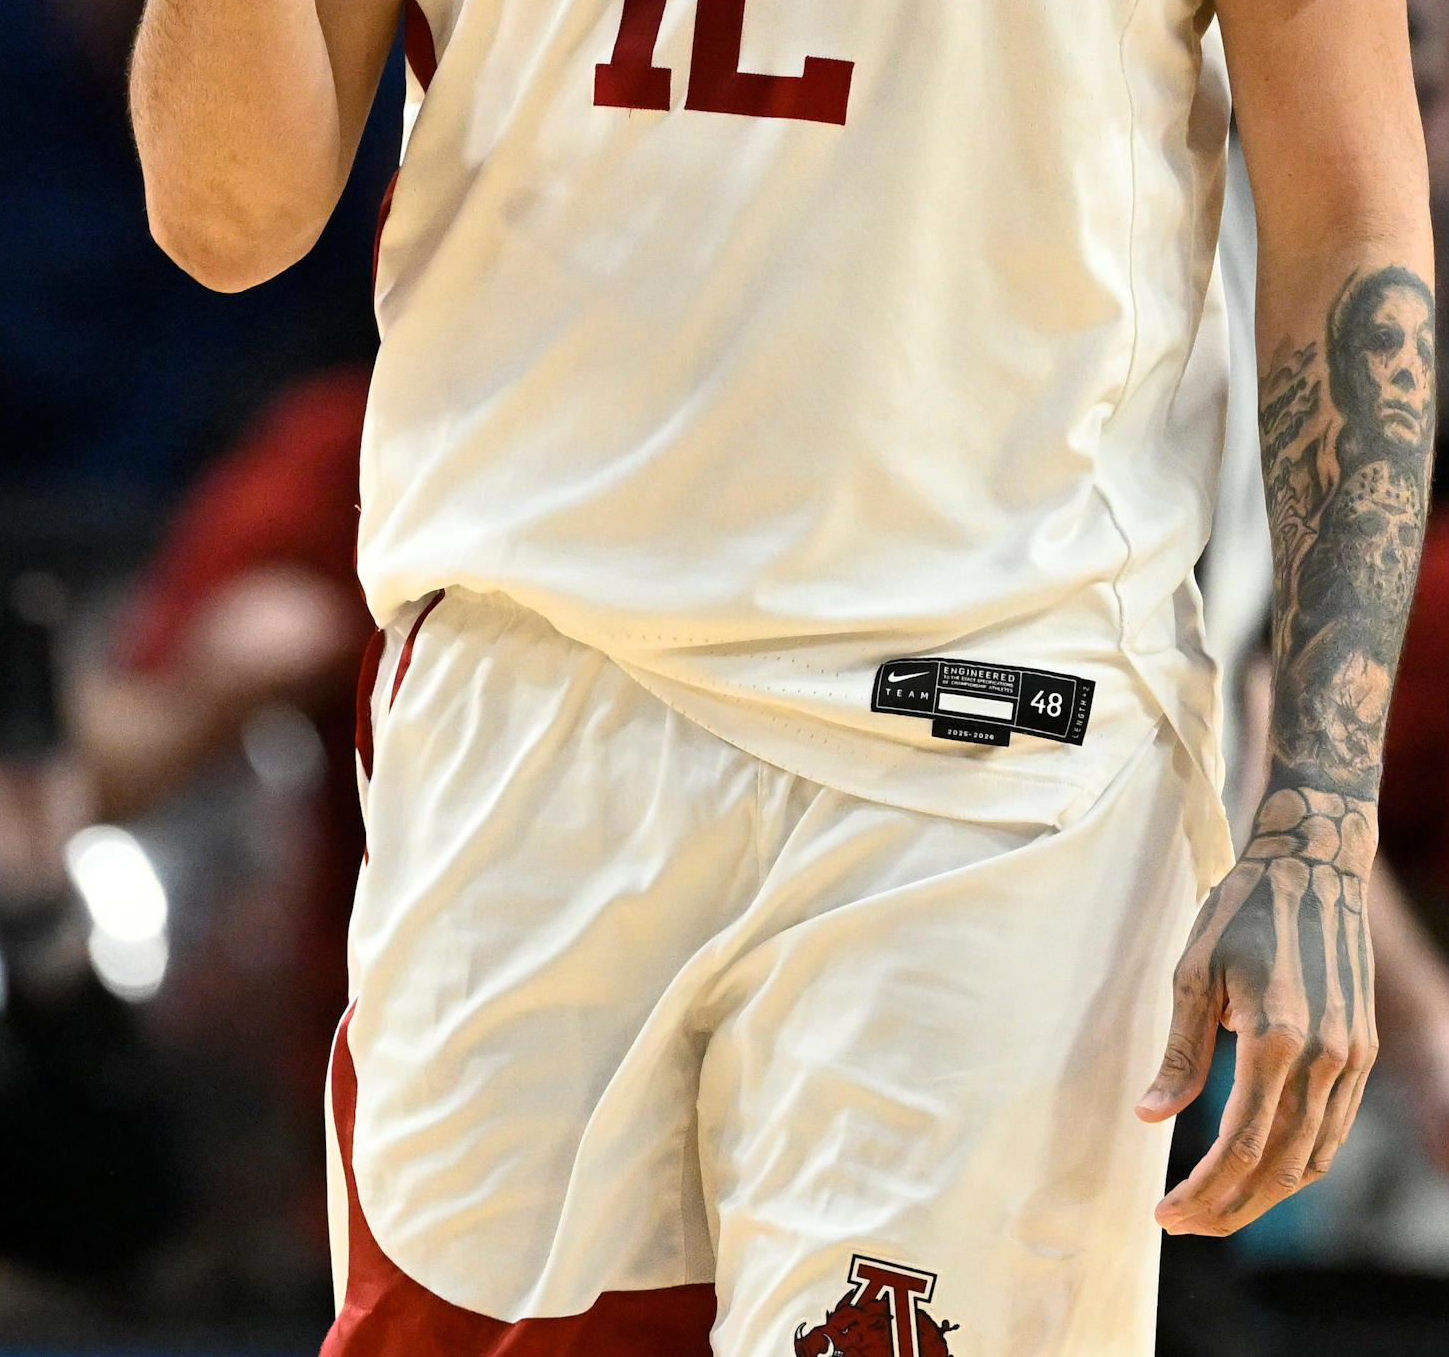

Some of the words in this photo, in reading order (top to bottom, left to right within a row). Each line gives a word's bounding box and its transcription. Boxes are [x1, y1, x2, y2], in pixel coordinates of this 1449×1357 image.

[943, 666, 1015, 683] ENGINEERED
[885, 687, 929, 701] TEAM
[1030, 690, 1063, 717] 48
[947, 728, 995, 741] 2025-2026
